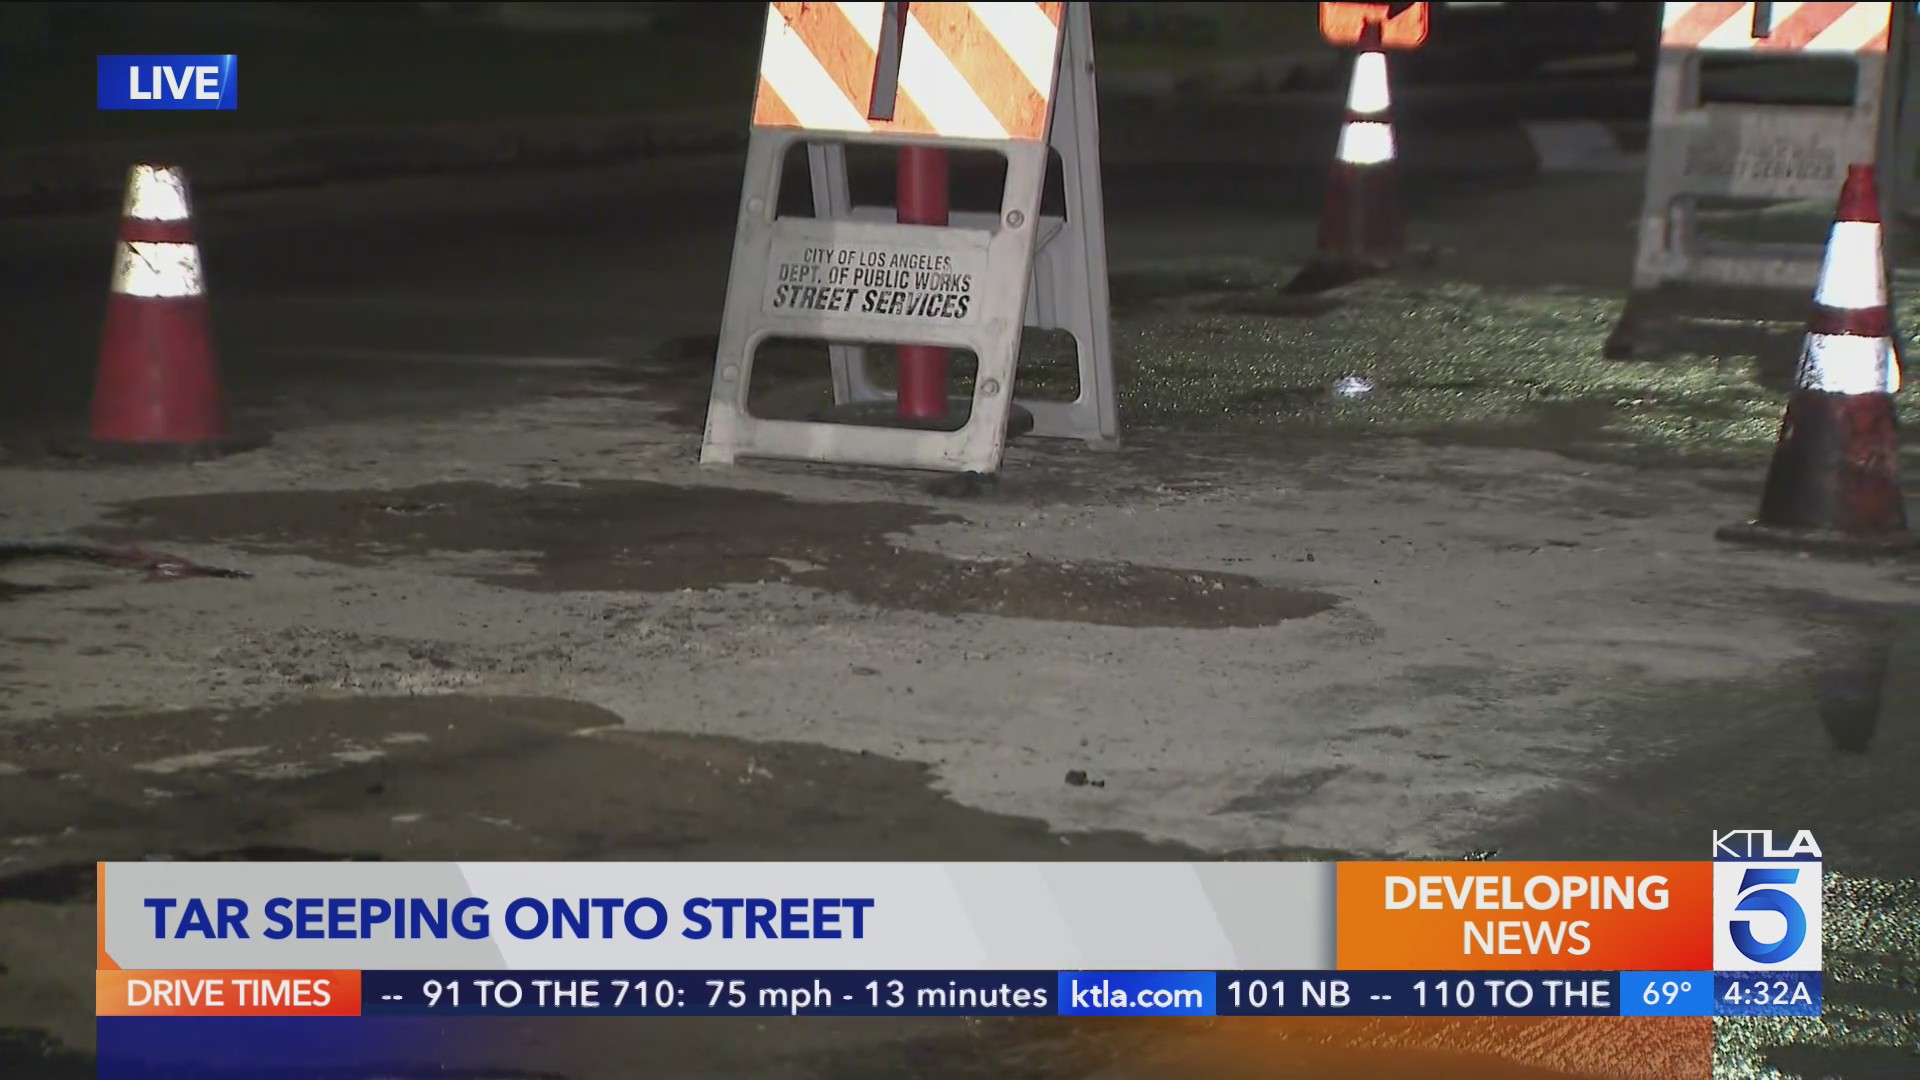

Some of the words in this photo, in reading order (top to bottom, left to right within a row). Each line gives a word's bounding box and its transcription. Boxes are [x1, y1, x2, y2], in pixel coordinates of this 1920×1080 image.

[804, 248, 834, 263] CITY
[838, 249, 856, 265] OF
[859, 251, 886, 267] LOS
[889, 253, 952, 271] ANGELES
[779, 263, 821, 283] DEPT.
[828, 266, 849, 284] OF
[853, 267, 909, 289] PUBLIC
[914, 271, 972, 292] WORKS
[773, 284, 859, 312] STREET
[861, 289, 970, 319] SERVICES
